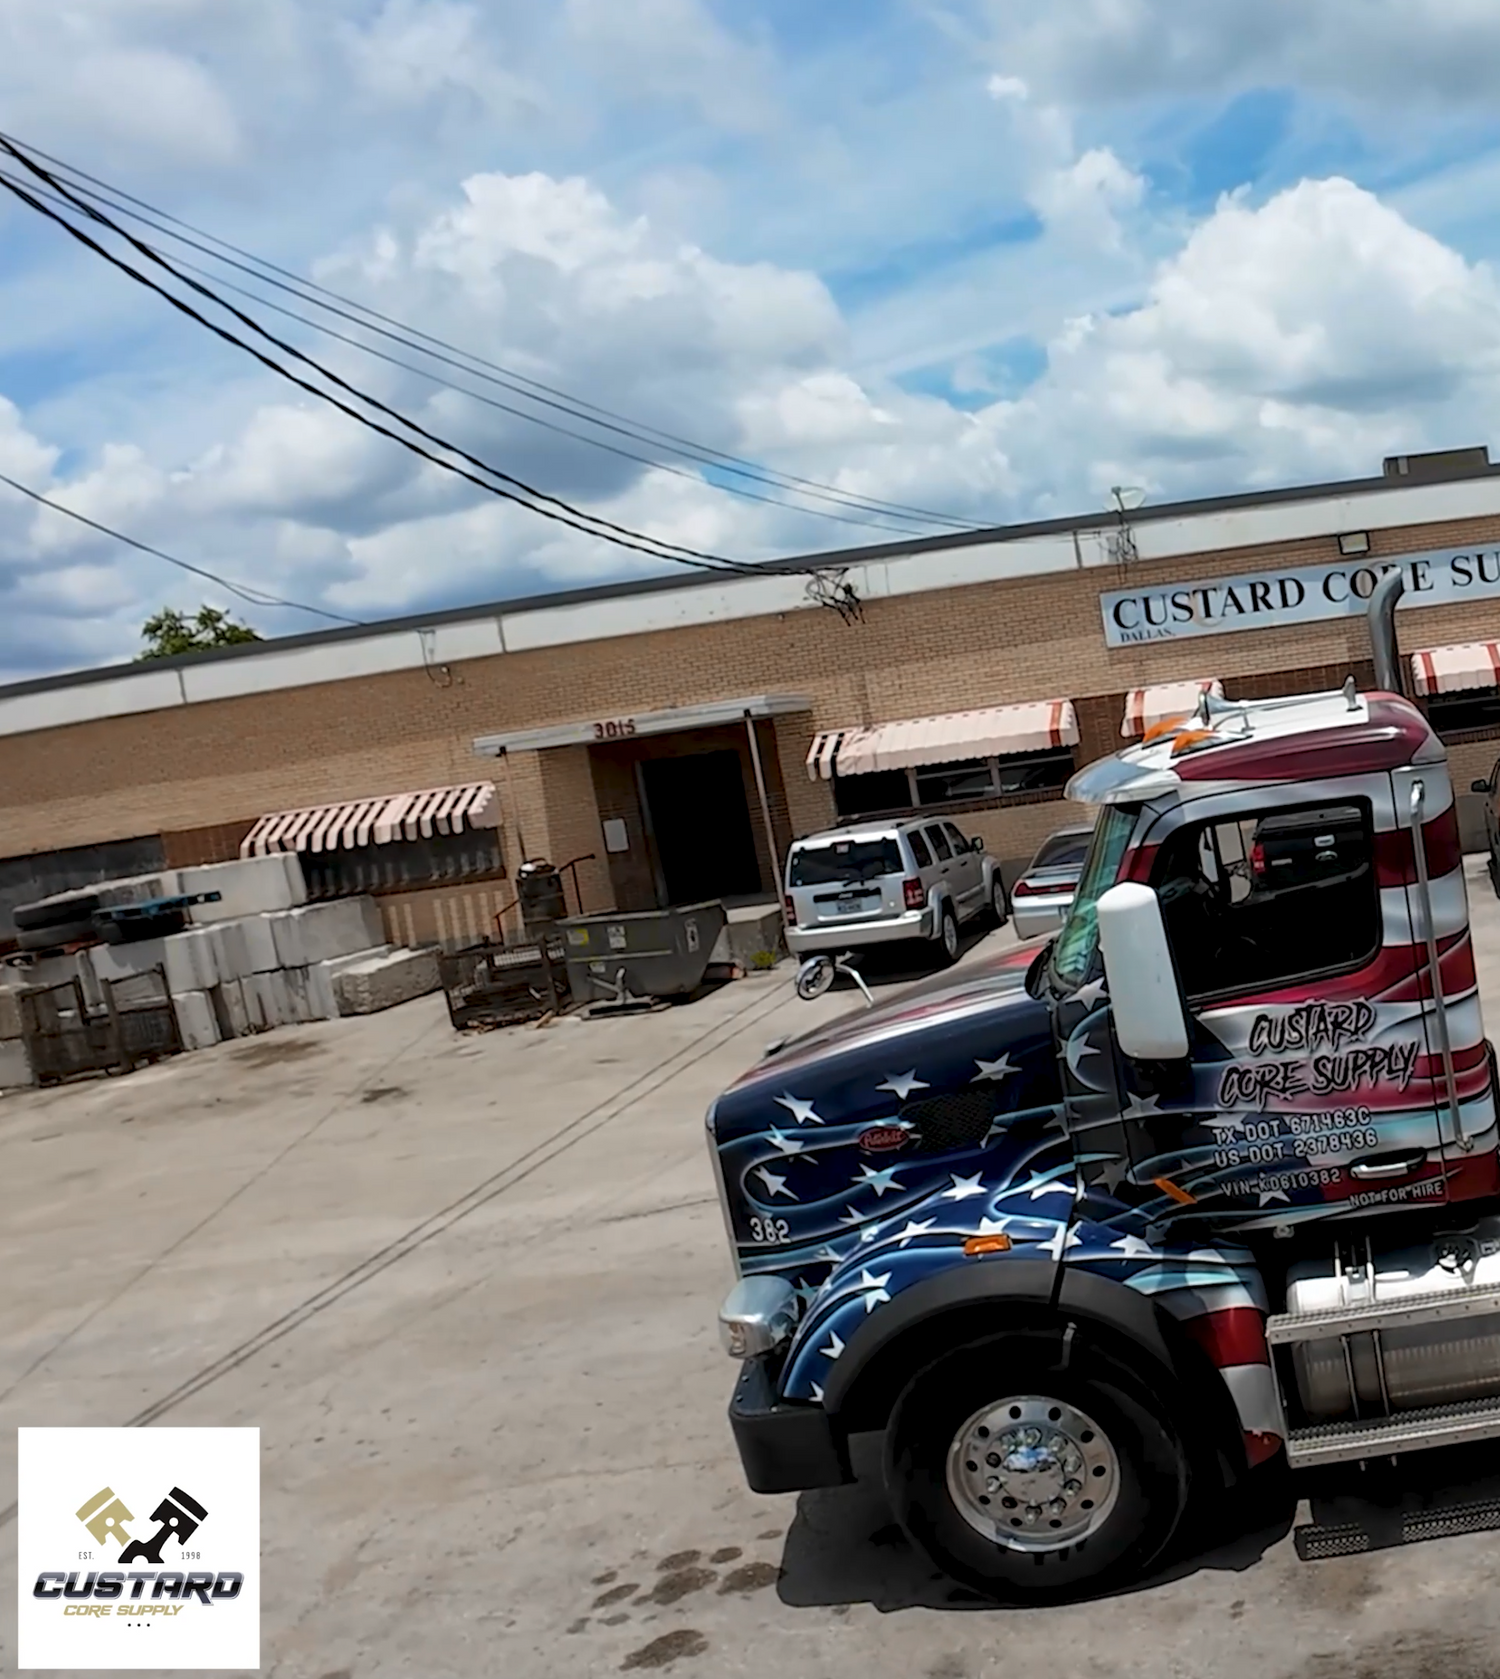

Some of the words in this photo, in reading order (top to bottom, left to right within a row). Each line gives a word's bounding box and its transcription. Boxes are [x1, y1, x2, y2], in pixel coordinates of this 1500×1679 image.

[1113, 577, 1306, 630] CUSTARD
[1322, 560, 1435, 603] COE
[593, 718, 636, 739] 3015
[1248, 996, 1377, 1057] CUSTARD
[1217, 1060, 1311, 1112] CORE
[1310, 1038, 1420, 1096] SUPPLY
[1212, 1126, 1237, 1146] TX
[1245, 1120, 1280, 1142] DOT
[1290, 1106, 1371, 1136] 671463C
[1293, 1129, 1378, 1158] 2378436
[1349, 1191, 1376, 1209] NOT
[1380, 1187, 1408, 1203] FOR
[1411, 1181, 1443, 1199] HIRE
[750, 1216, 792, 1244] 382
